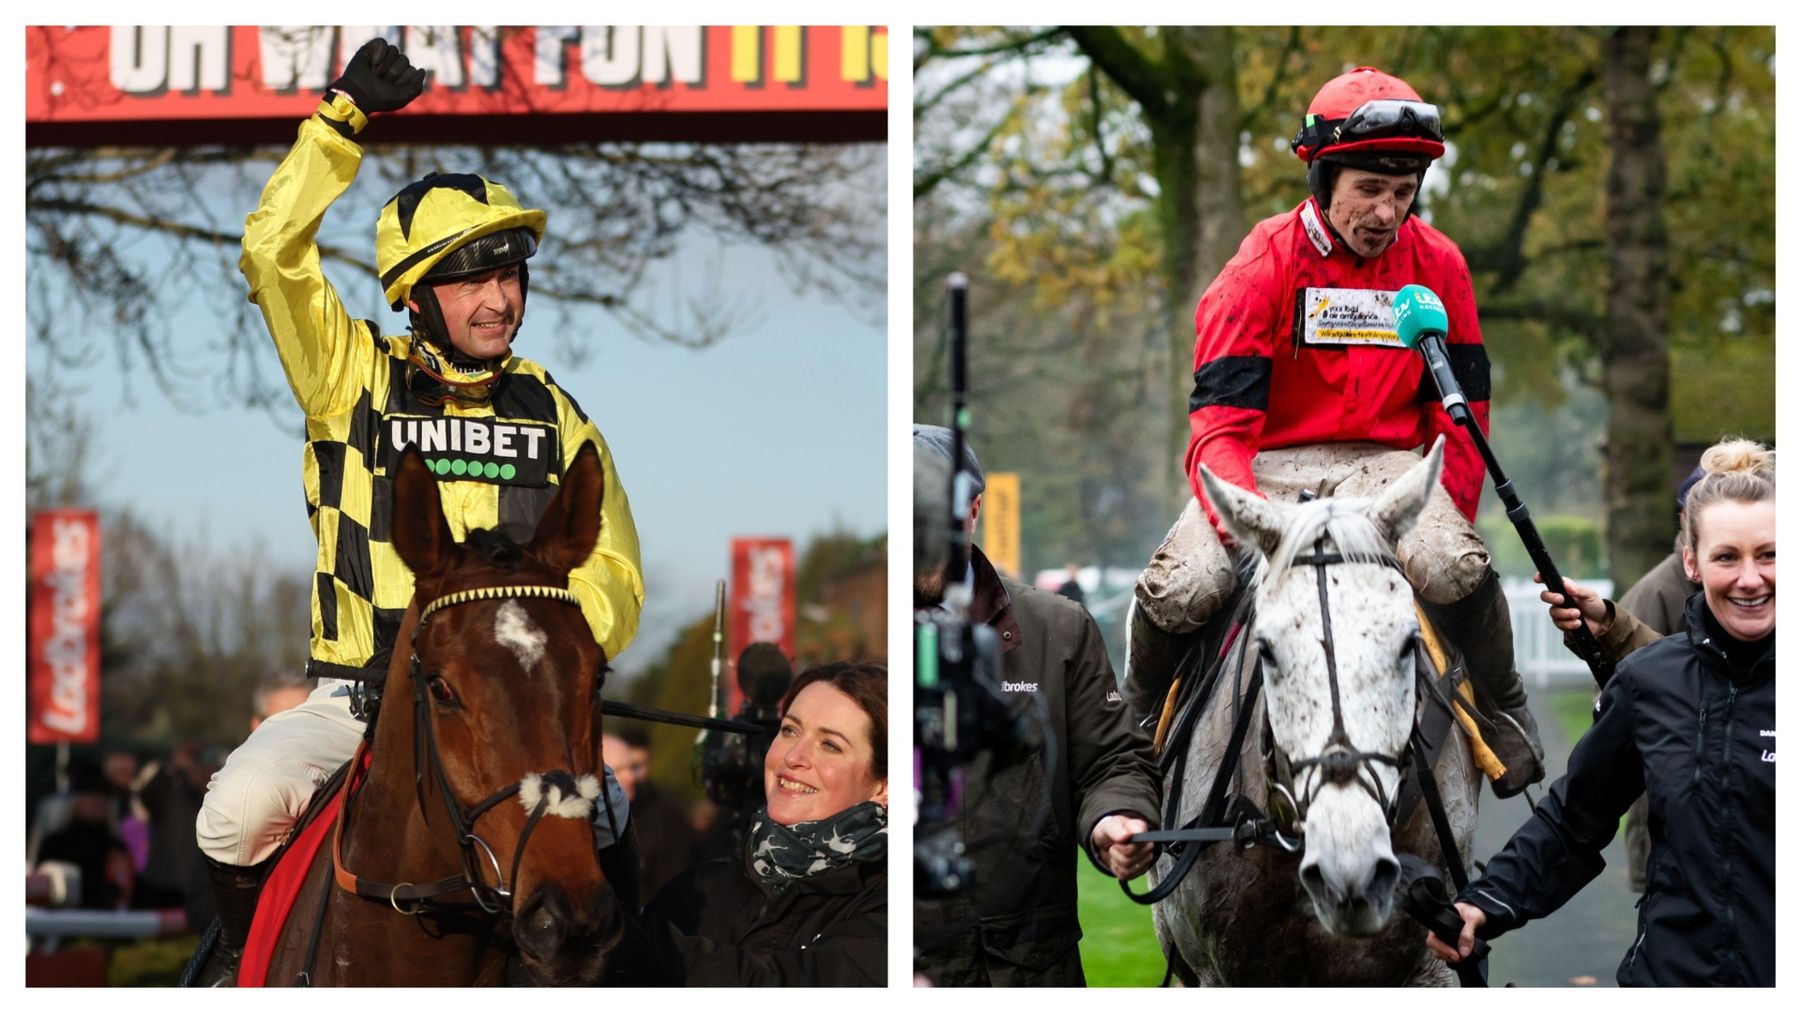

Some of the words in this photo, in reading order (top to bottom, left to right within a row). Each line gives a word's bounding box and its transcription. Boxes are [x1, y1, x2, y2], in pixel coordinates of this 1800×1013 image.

[109, 25, 229, 91] OH
[534, 25, 702, 85] FUN
[391, 418, 545, 460] UNIBET
